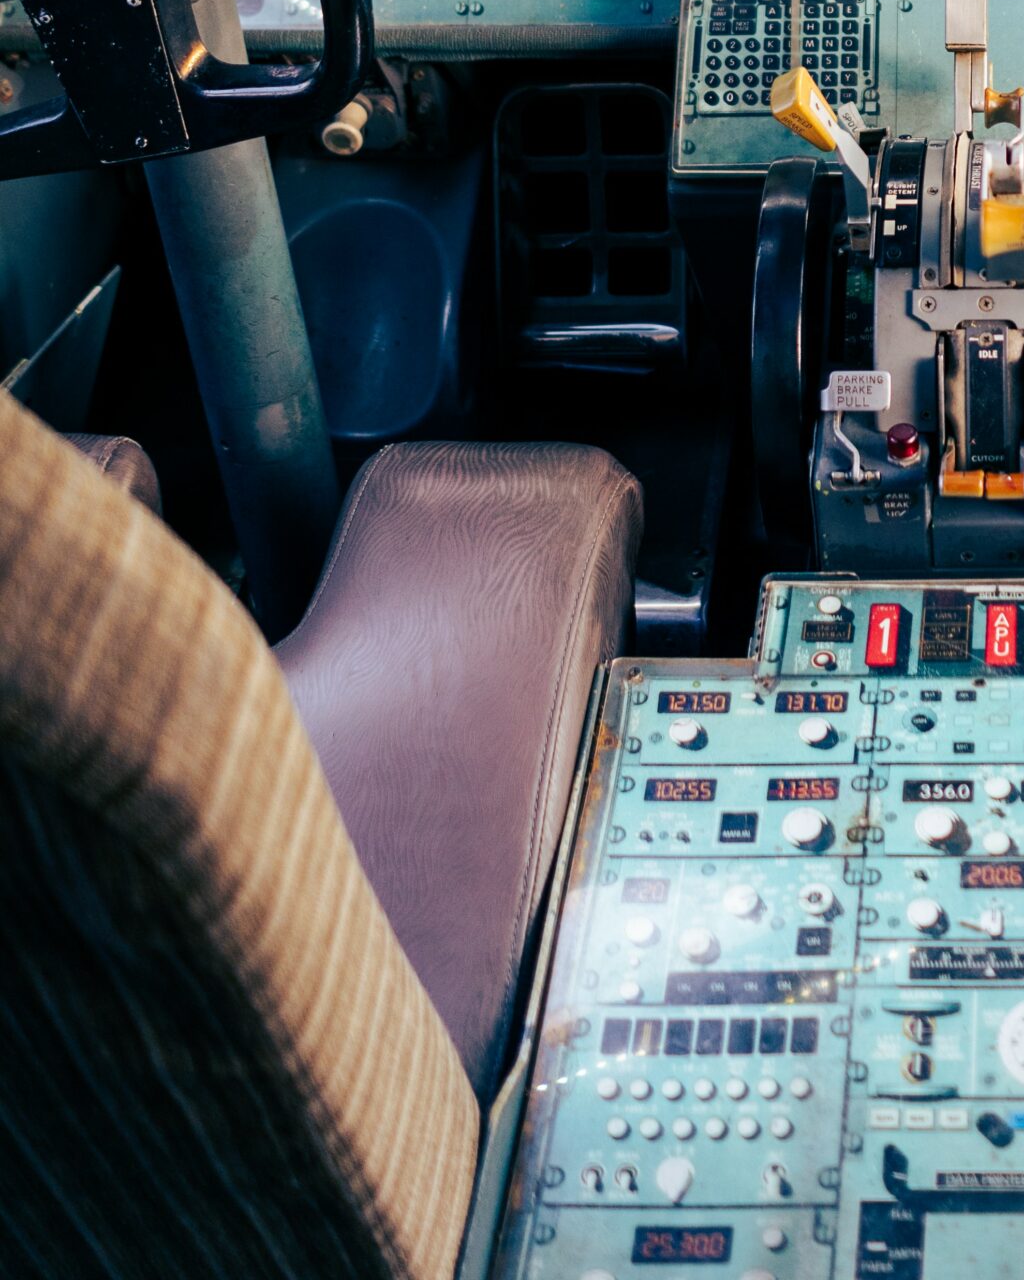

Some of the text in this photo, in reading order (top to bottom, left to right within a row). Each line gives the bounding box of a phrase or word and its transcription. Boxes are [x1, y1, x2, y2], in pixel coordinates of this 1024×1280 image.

[972, 165, 982, 189] THRUST
[979, 350, 997, 359] IDLE
[837, 376, 883, 384] PARKING
[837, 386, 872, 394] BRAKE
[837, 397, 869, 407] PULL
[879, 617, 891, 654] 1
[994, 613, 1010, 656] APU
[668, 694, 843, 712] 121.50 131.70
[655, 783, 711, 799] 102.55
[967, 865, 1022, 886] 2006
